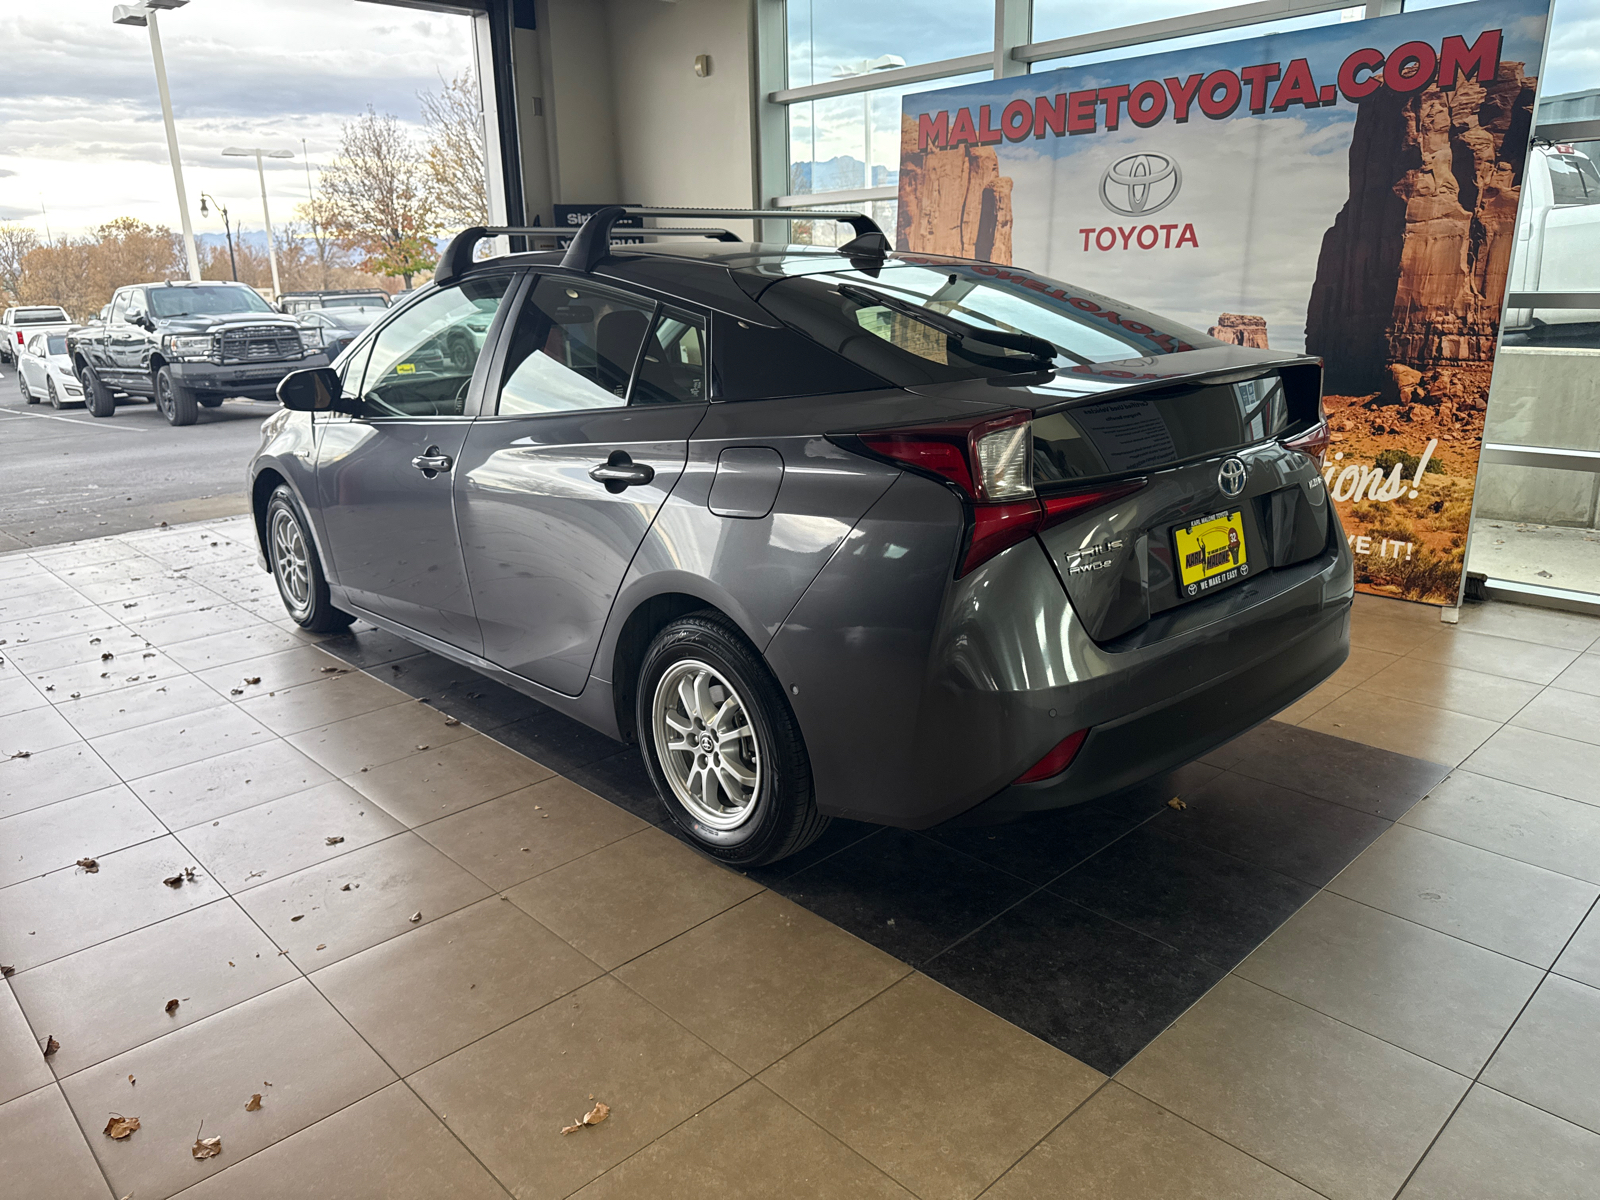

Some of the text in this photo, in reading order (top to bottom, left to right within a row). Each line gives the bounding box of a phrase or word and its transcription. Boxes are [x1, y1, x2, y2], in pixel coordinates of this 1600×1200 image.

[917, 28, 1503, 153] MALONETOYOTA.COM
[1079, 223, 1199, 252] TOYOTA
[1230, 533, 1237, 542] 32
[1064, 539, 1124, 563] PRIUS
[1186, 551, 1202, 569] KARL
[1207, 550, 1230, 570] MALONE
[1380, 538, 1413, 561] IT!
[1201, 569, 1237, 590] WE MAKE IT EASY
